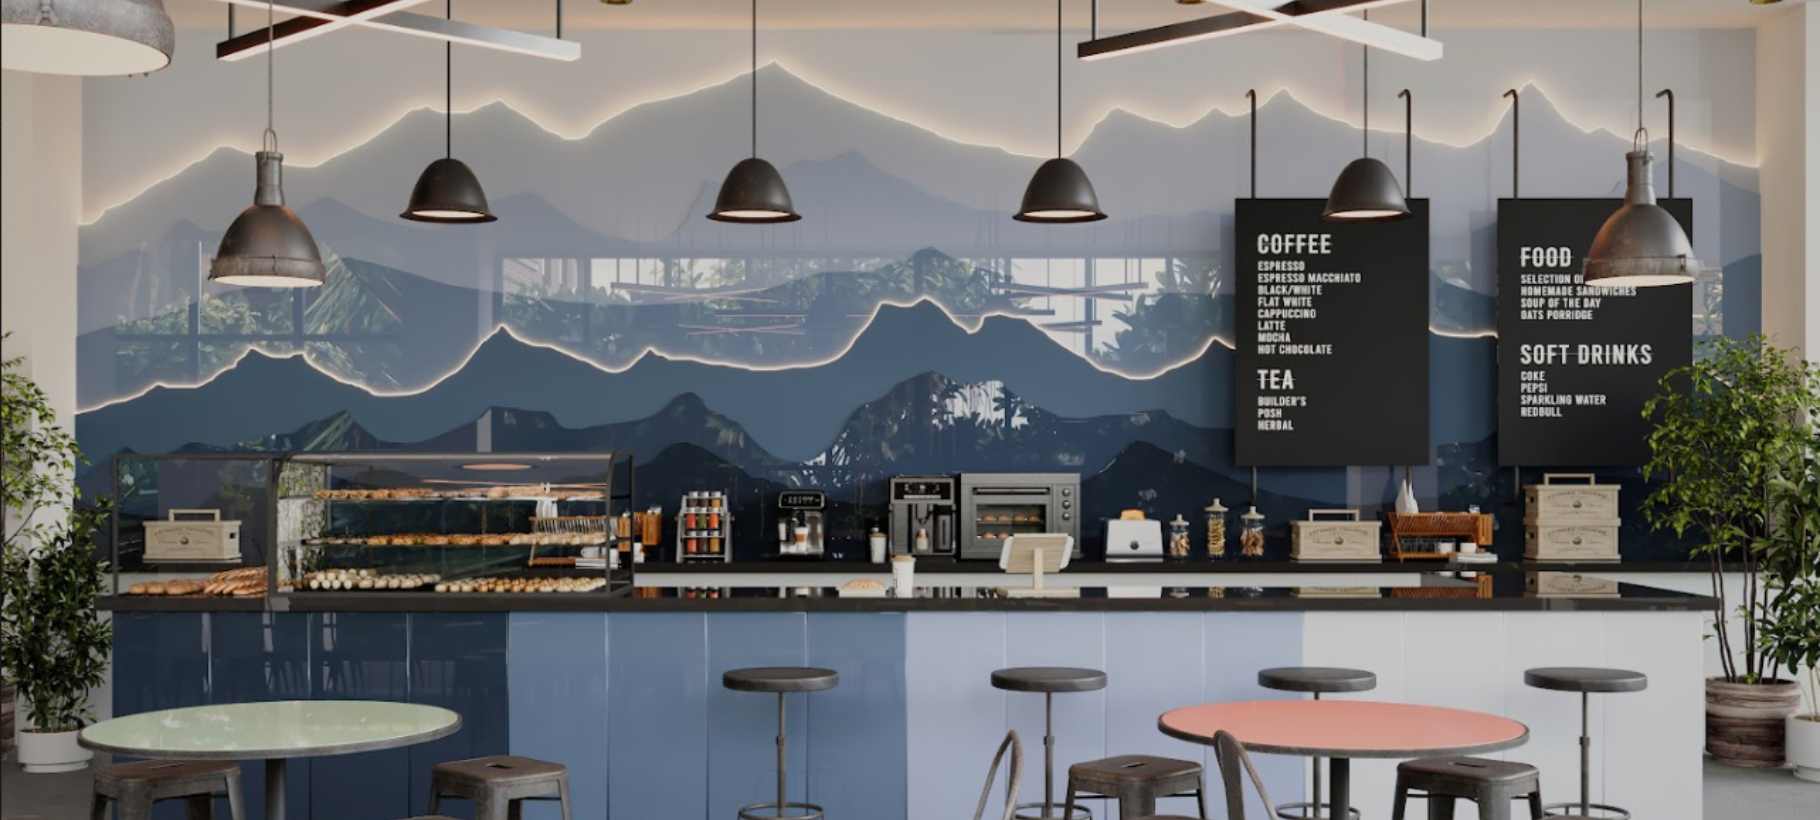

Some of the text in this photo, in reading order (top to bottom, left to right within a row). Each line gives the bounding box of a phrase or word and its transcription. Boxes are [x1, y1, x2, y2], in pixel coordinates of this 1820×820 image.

[1258, 234, 1331, 254] COFFEE
[1520, 247, 1571, 267] FOOD
[1258, 261, 1305, 271] ESPRESSO
[1258, 273, 1361, 283] ESPRESSO MACCHIATO
[1521, 274, 1571, 284] SELECTION
[1258, 285, 1322, 295] BLACK/WHITE
[1521, 286, 1637, 297] HOMEMADE SANDWICHES
[1258, 296, 1312, 307] FLAT WHITE
[1521, 298, 1601, 308] SOUP OF THE DAY
[1258, 309, 1316, 319] CAPPUCCINO
[1521, 310, 1593, 320] OATS PORRIDGE
[1258, 320, 1285, 331] LATTE
[1258, 332, 1290, 342] MOCHA
[1258, 344, 1332, 354] HOT CHOCOLATE
[1520, 344, 1652, 364] SOFT DRINKS
[1257, 369, 1294, 389] TEA
[1521, 371, 1545, 381] COKE
[1521, 383, 1547, 393] PEPSI
[1521, 394, 1606, 405] SPARKLING WATER
[1258, 408, 1282, 418] POSH
[1521, 407, 1562, 417] REDBULL
[1258, 420, 1293, 430] HERBAL
